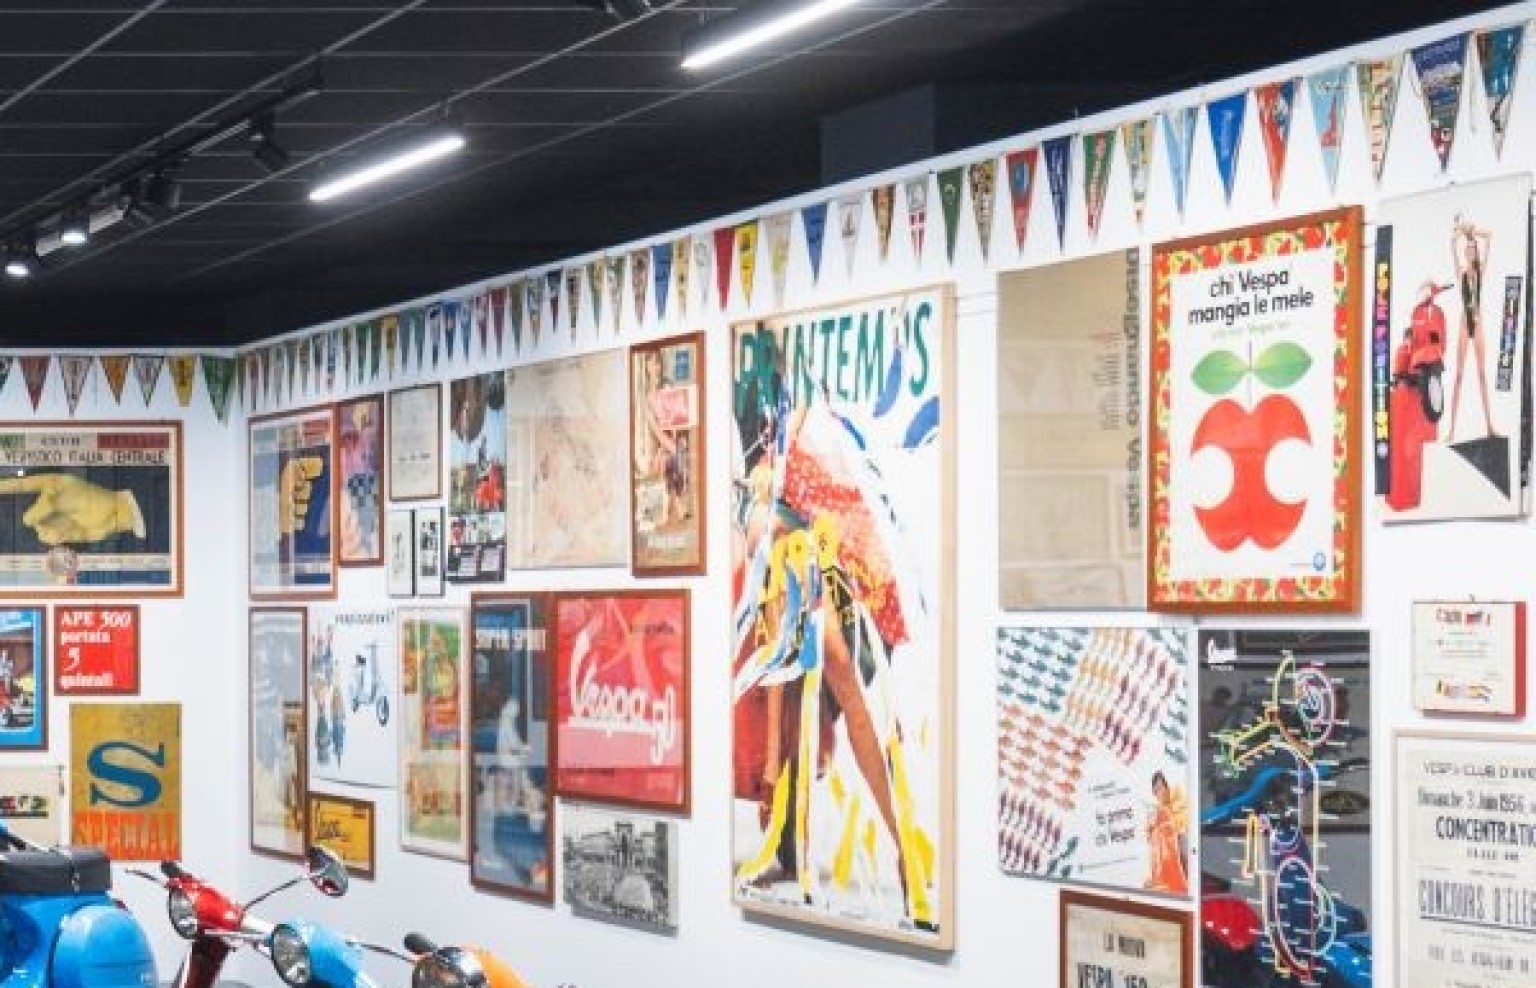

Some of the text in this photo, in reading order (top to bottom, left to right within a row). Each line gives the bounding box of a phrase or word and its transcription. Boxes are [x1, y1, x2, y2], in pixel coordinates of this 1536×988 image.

[1209, 269, 1289, 297] chi Vespa
[1188, 286, 1313, 326] mangia le mele
[61, 611, 132, 630] APE 500
[60, 631, 111, 645] portata
[567, 613, 655, 738] Vespa
[86, 741, 165, 807] S
[1464, 764, 1496, 777] CLUB
